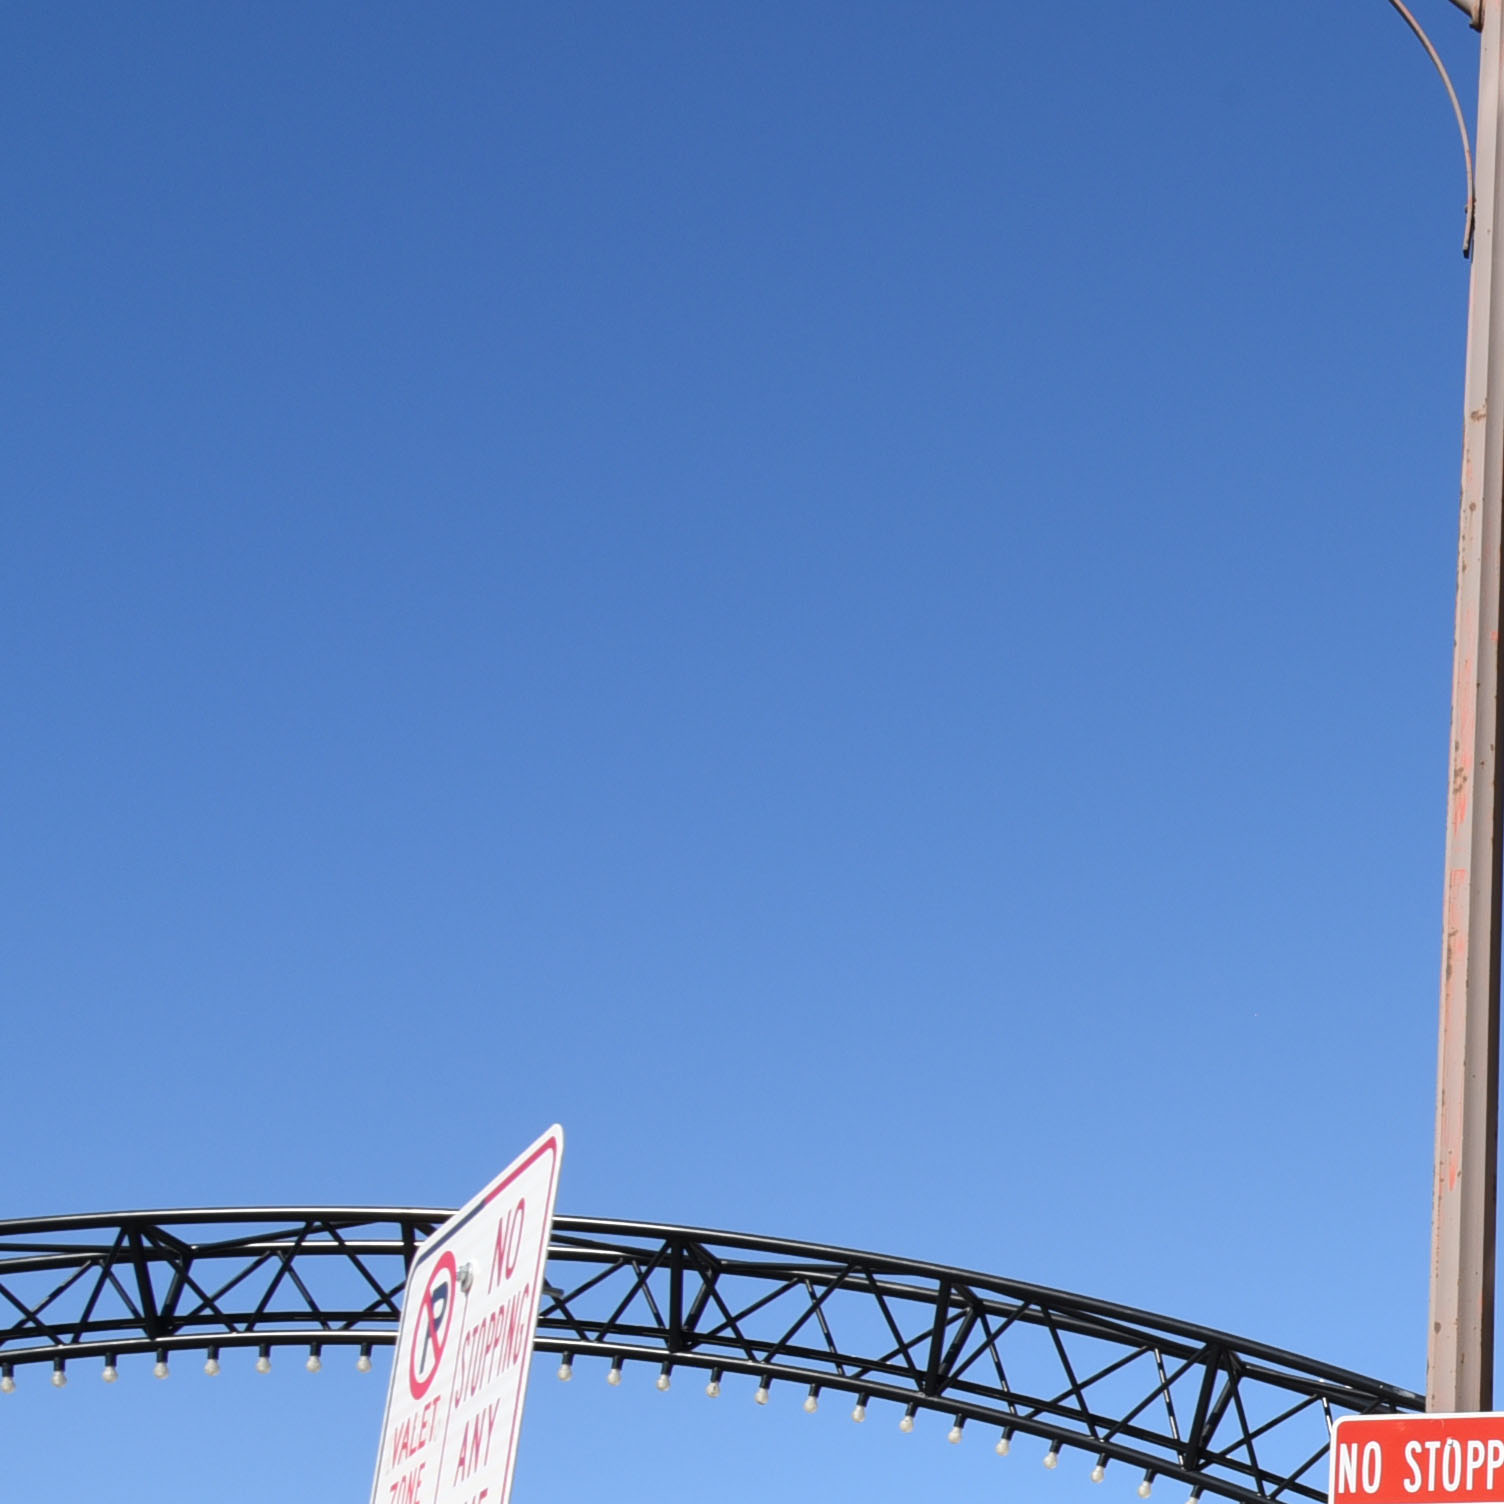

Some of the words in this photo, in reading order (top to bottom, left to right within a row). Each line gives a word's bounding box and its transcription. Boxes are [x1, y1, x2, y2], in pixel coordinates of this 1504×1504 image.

[488, 1197, 526, 1296] NO
[453, 1283, 530, 1409] STOPPING
[390, 1395, 441, 1461] VALET
[453, 1398, 501, 1487] ANY
[1337, 1440, 1382, 1494] NO
